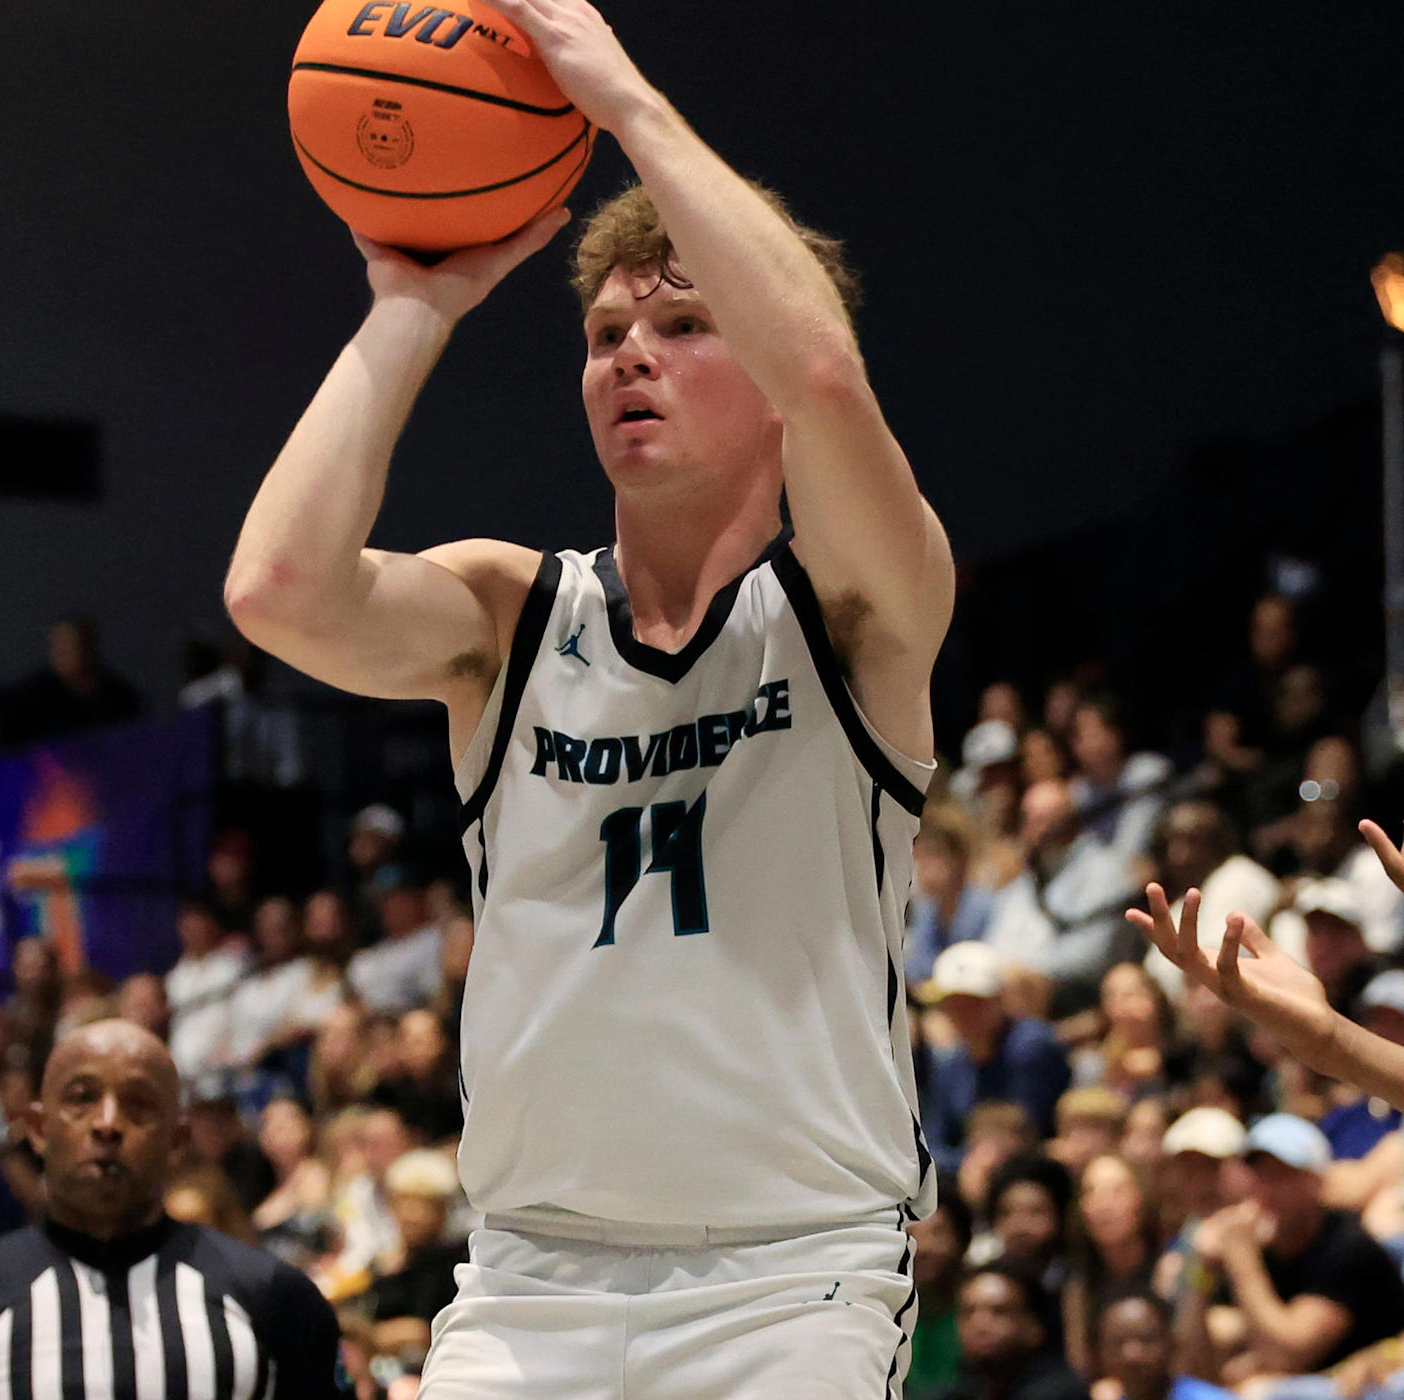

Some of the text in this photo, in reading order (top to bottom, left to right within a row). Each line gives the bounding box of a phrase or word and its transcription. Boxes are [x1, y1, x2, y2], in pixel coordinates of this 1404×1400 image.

[347, 0, 514, 50] EVO NXT
[590, 788, 711, 952] 14
